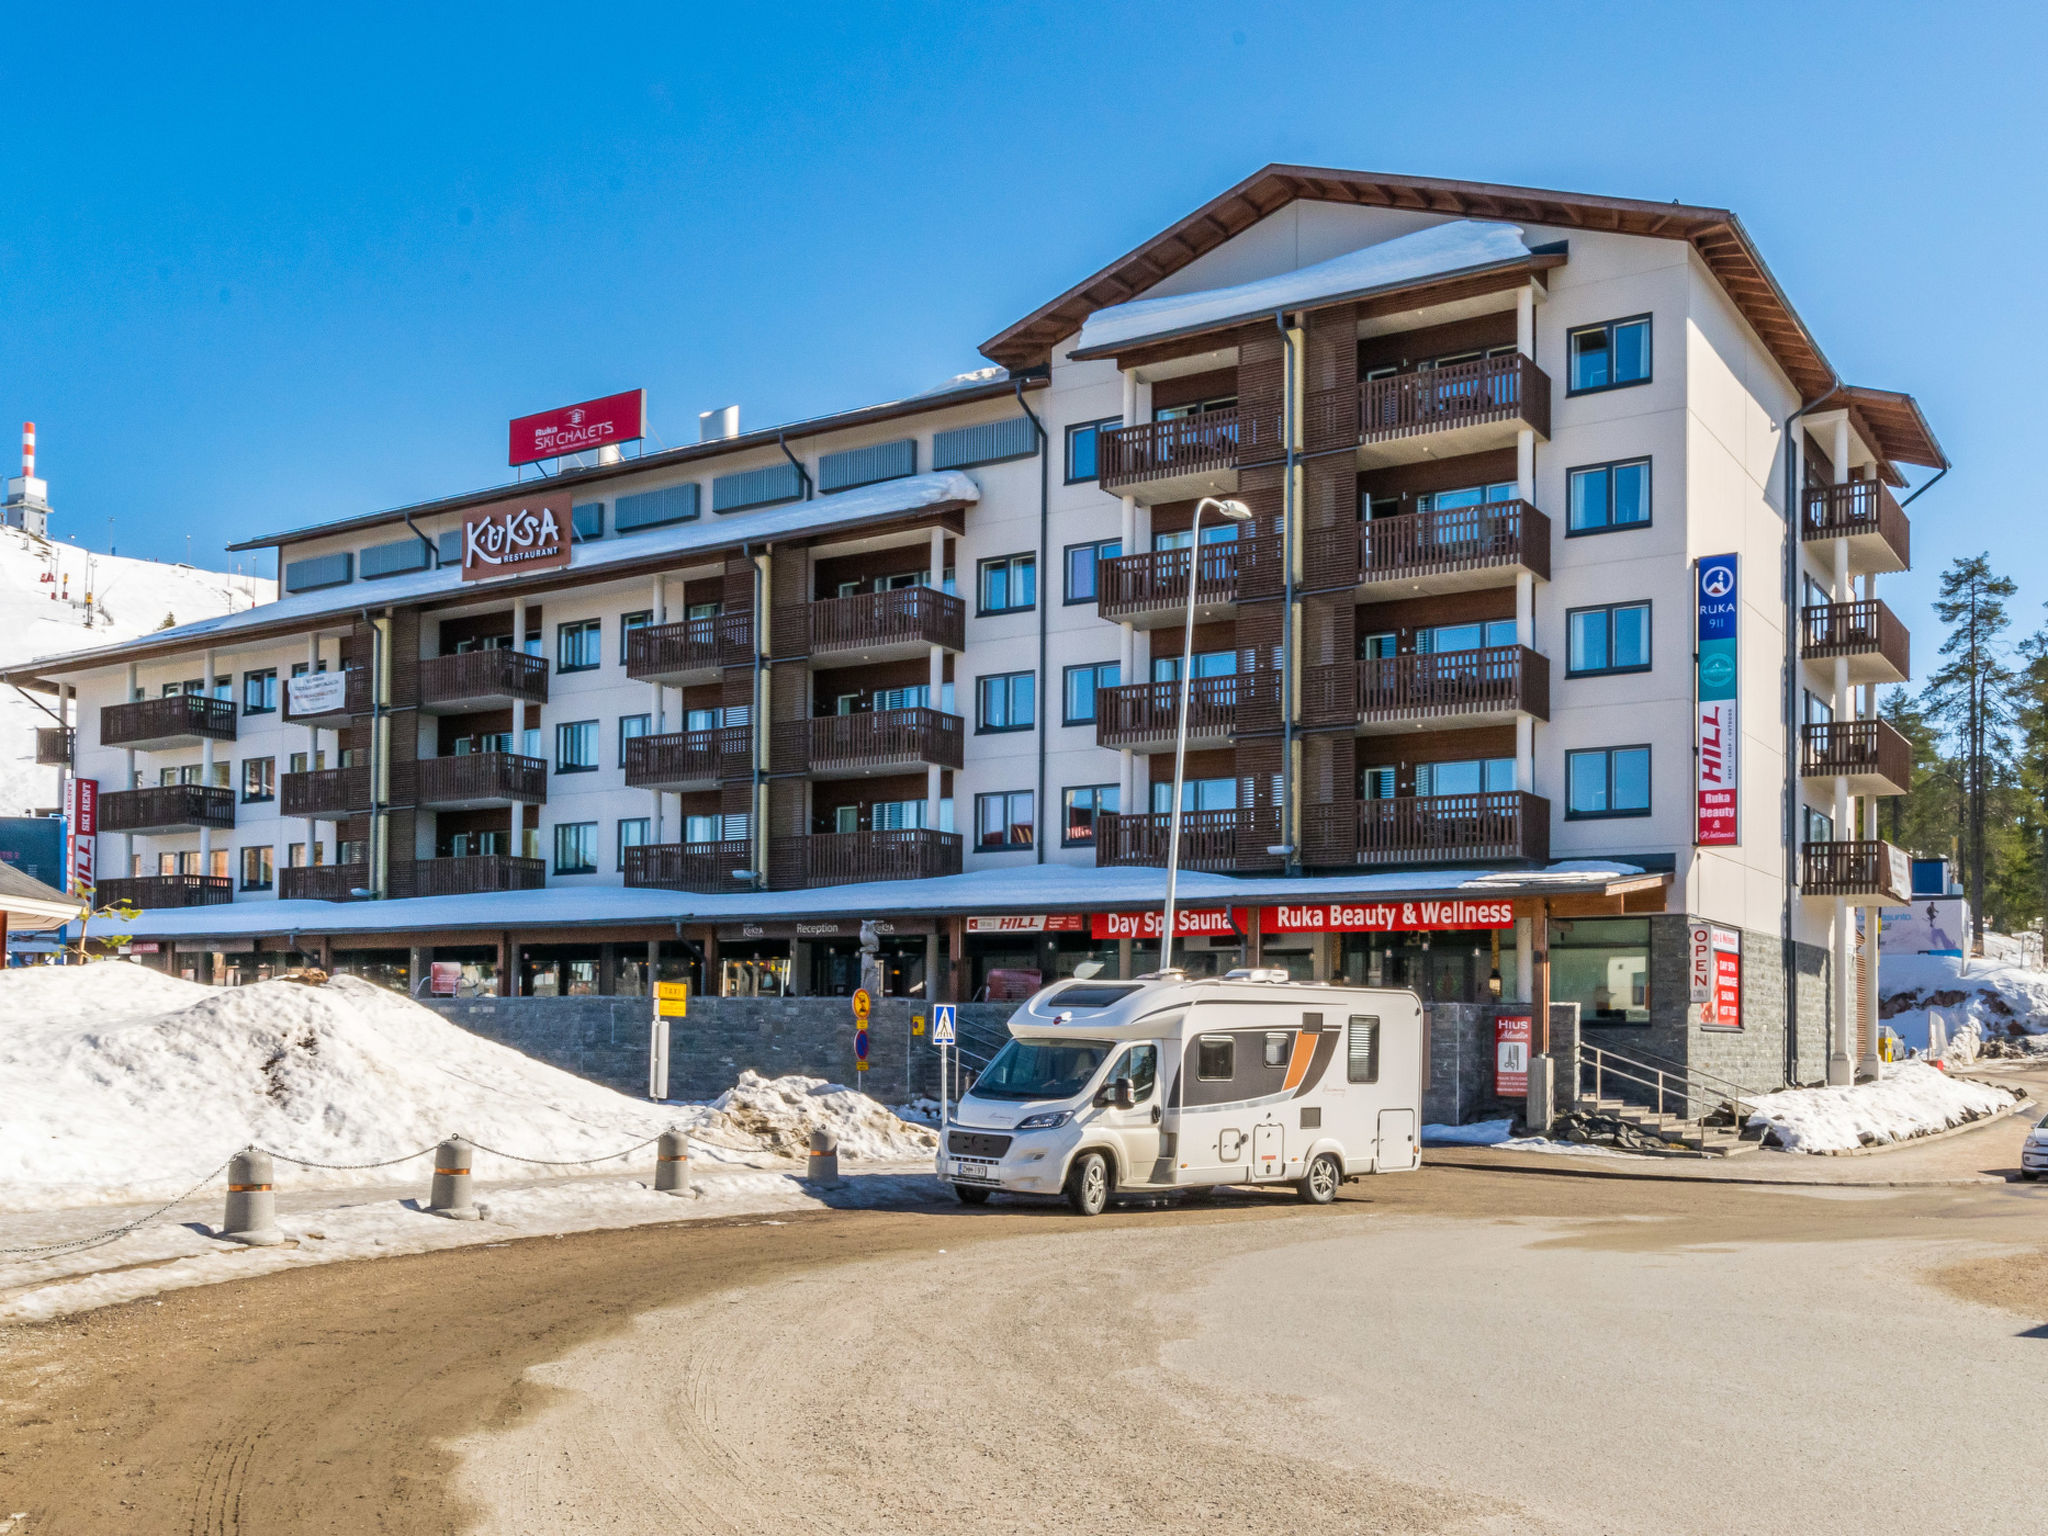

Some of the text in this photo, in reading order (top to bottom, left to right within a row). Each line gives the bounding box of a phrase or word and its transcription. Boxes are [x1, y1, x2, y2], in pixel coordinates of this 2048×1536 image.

[535, 426, 558, 437] Ruka
[535, 435, 554, 451] SKI
[556, 421, 614, 445] CHALETS
[465, 507, 560, 568] KUKSA
[503, 546, 559, 563] RESTAURANT
[1700, 603, 1736, 615] RUKA
[1709, 618, 1724, 629] 911
[1702, 706, 1722, 784] HILL
[1705, 793, 1730, 803] Ruka
[81, 782, 91, 831] SKI RENT
[1700, 807, 1735, 818] Beauty
[1712, 819, 1721, 829] &
[1278, 901, 1512, 930] Ruka Beauty & Wellness
[796, 923, 839, 936] Reception
[999, 917, 1038, 930] HILL
[1108, 912, 1139, 937] Day
[1144, 911, 1175, 937] Sp
[1178, 910, 1233, 931] Sauna
[1694, 930, 1708, 986] OPEN
